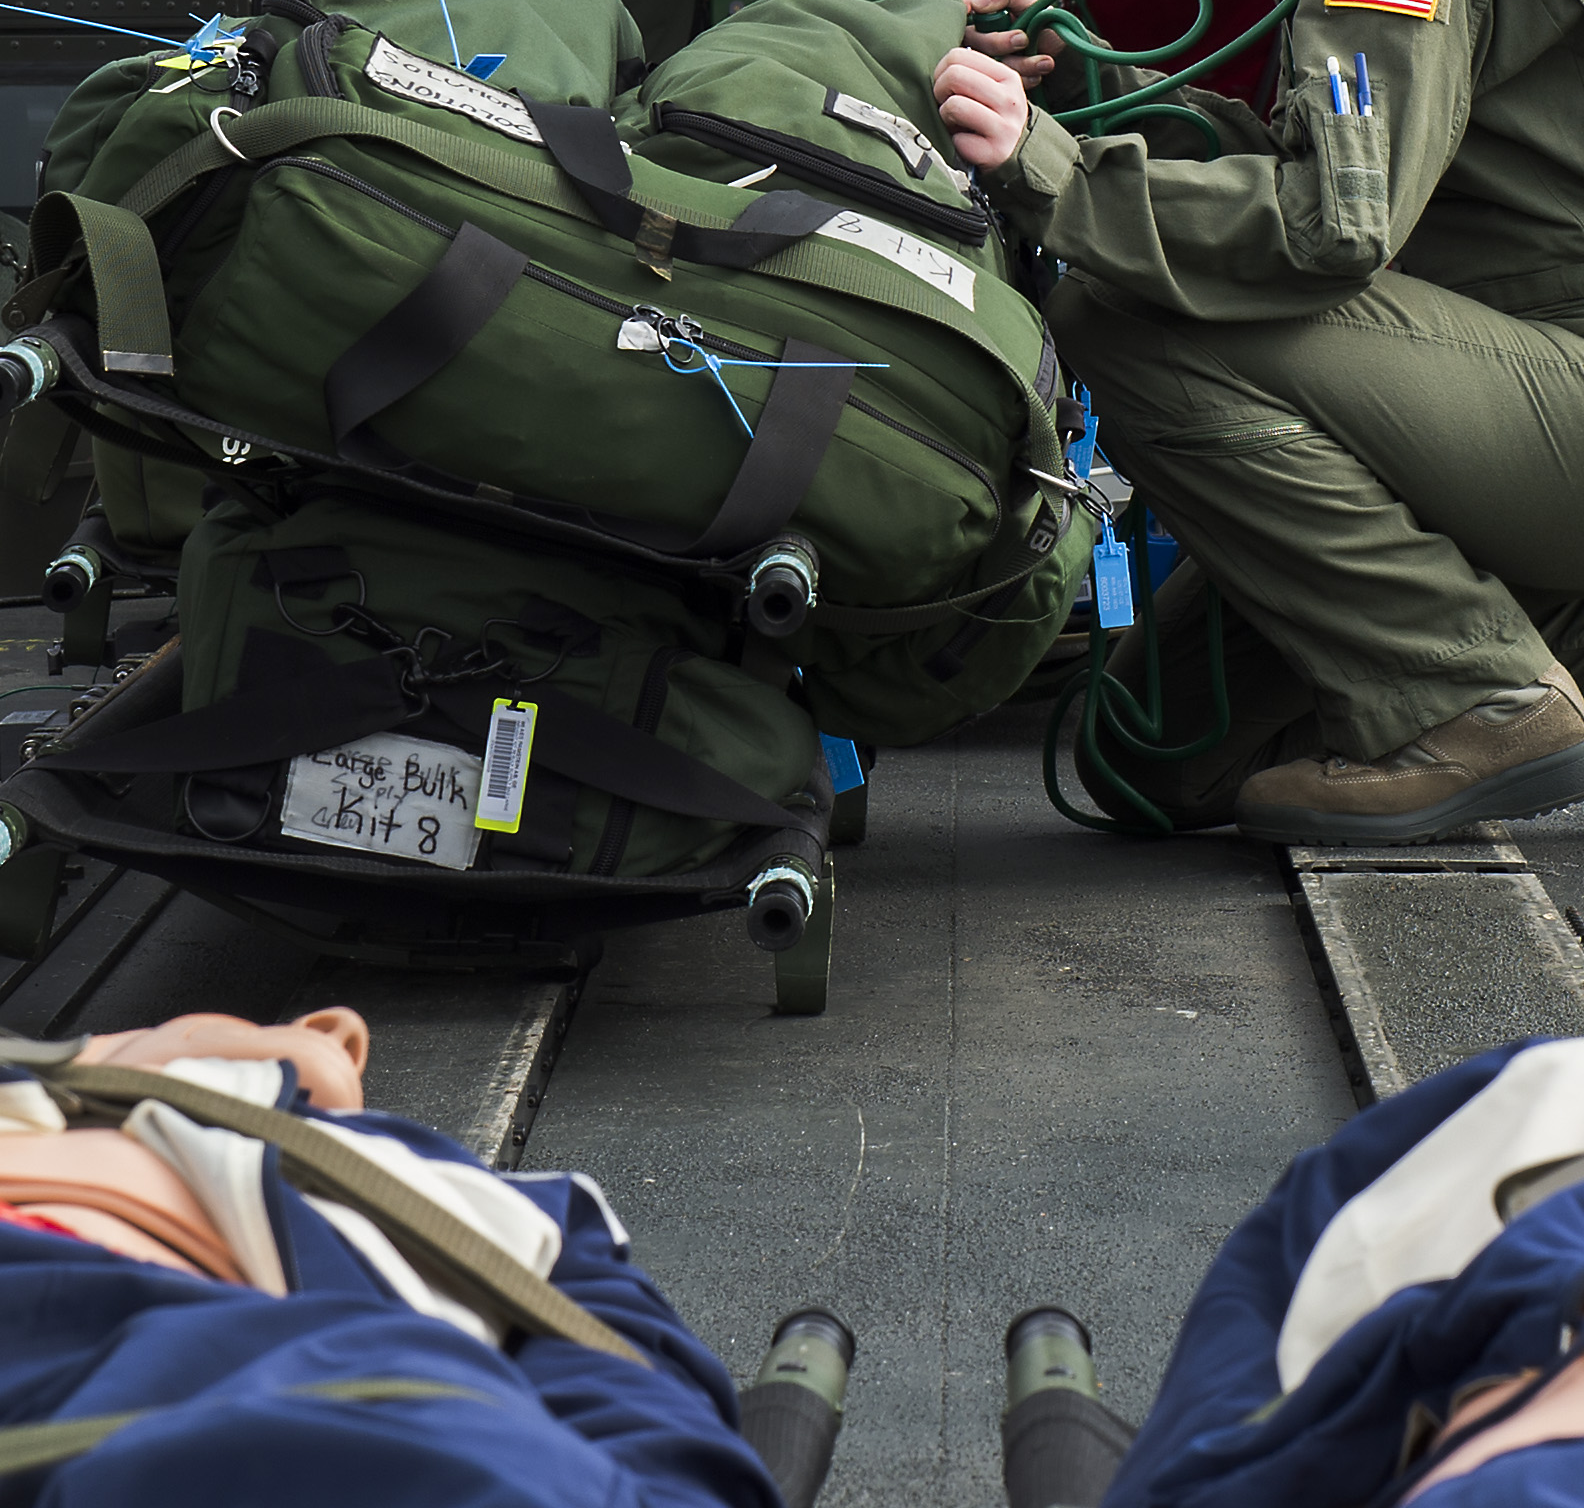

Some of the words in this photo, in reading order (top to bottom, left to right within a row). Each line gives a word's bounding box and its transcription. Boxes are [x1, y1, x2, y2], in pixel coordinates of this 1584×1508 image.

[383, 49, 533, 118] SOLUTION
[310, 750, 387, 789] Large
[403, 757, 468, 810] Bulk
[334, 786, 402, 844] Kit
[417, 816, 441, 855] 8
